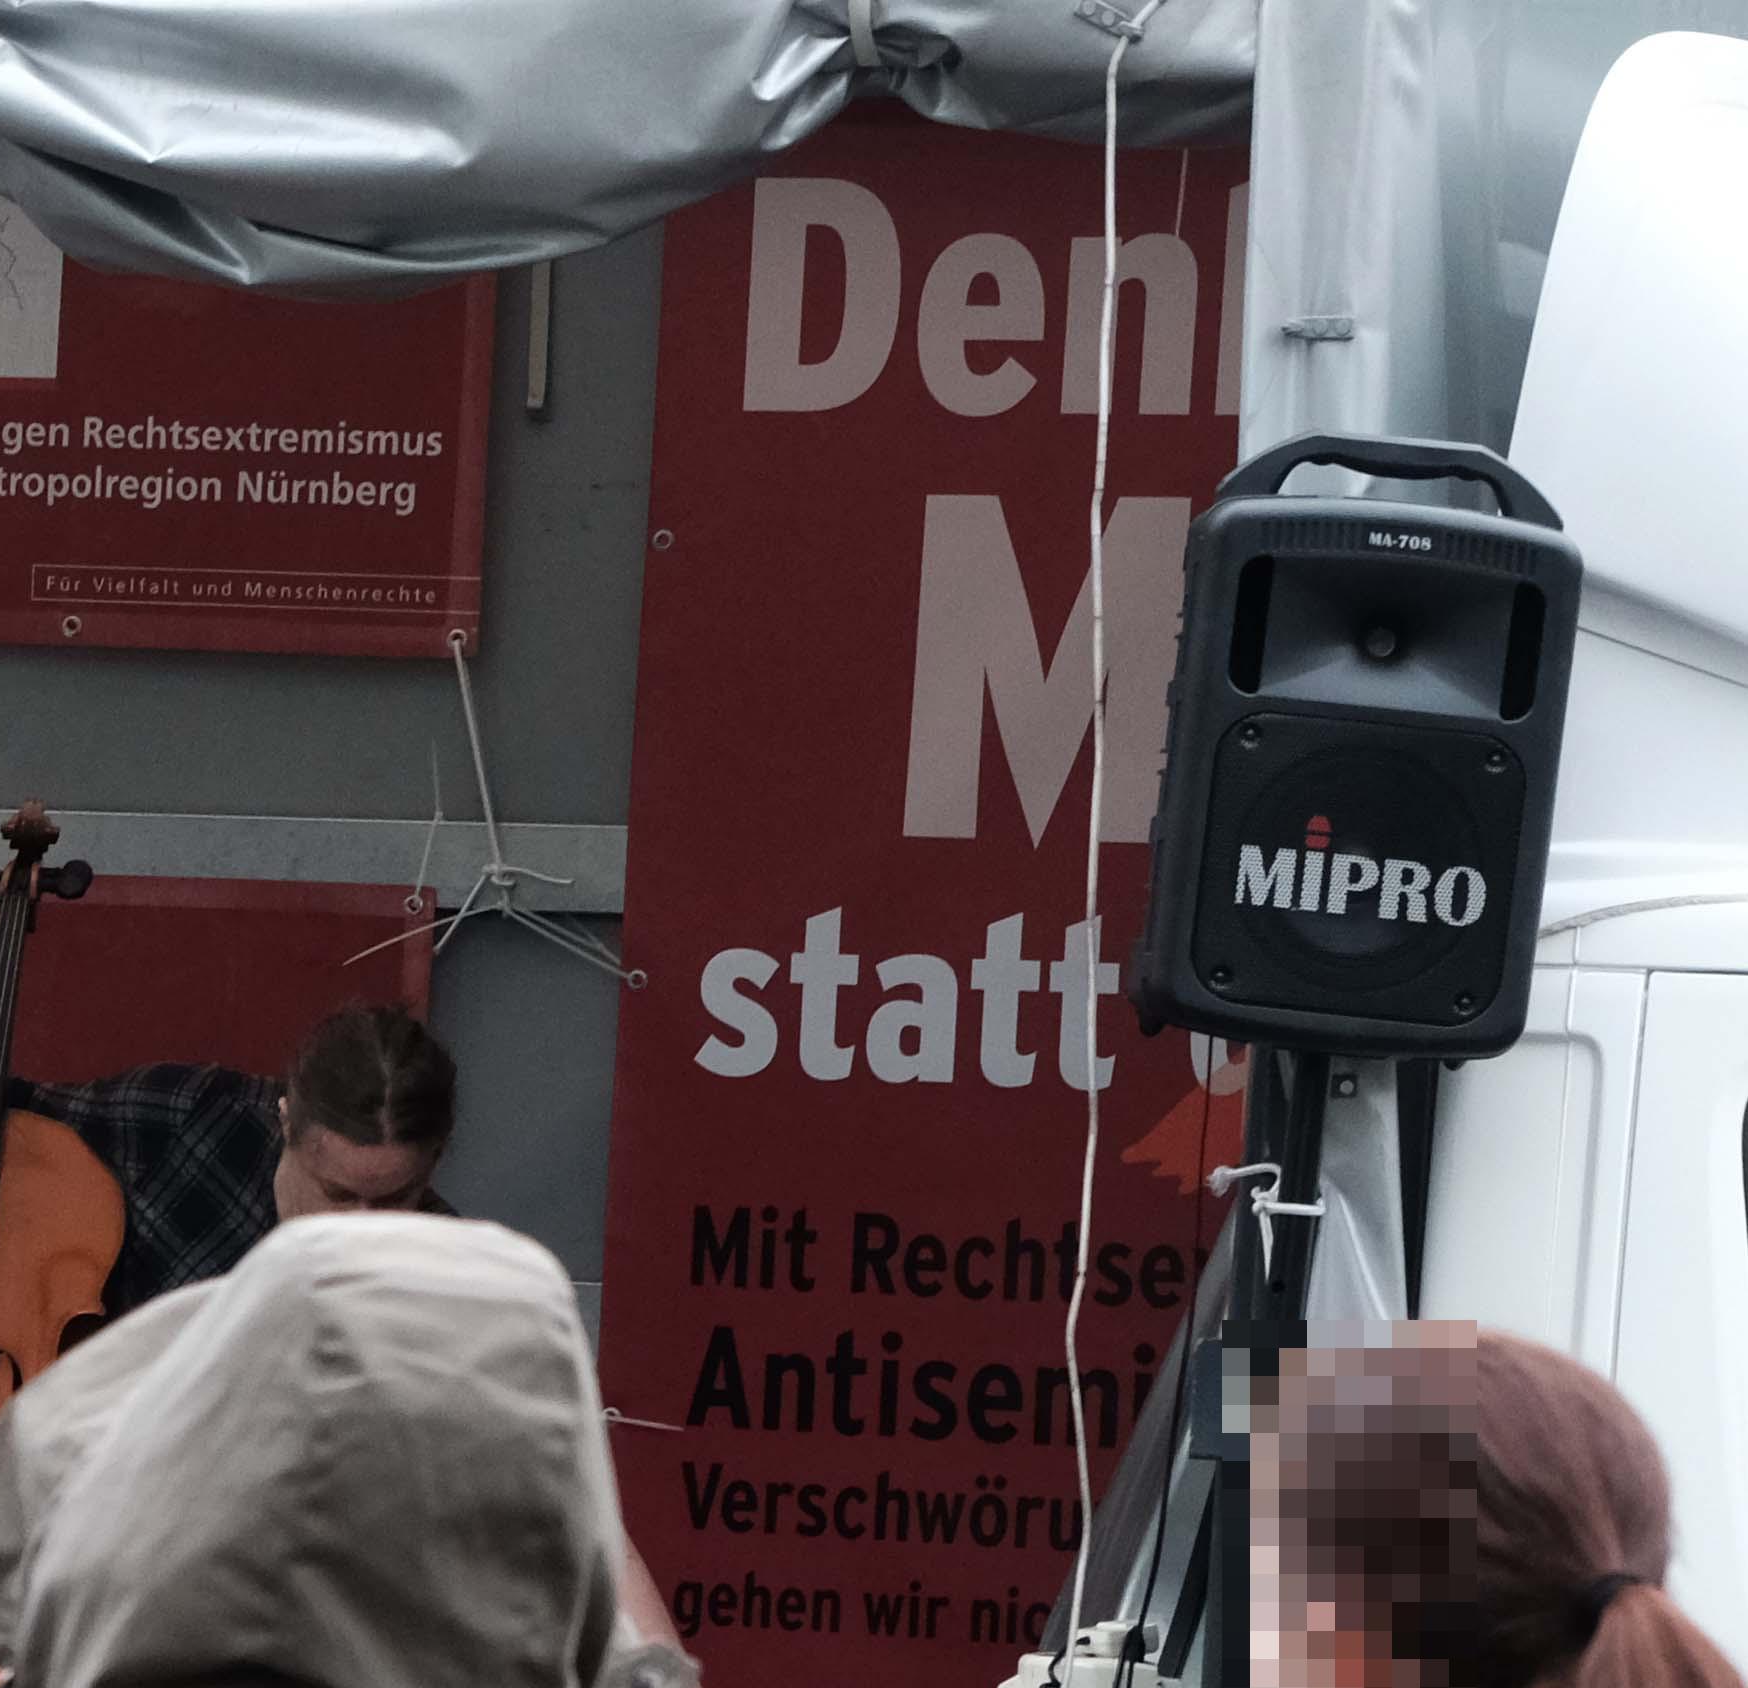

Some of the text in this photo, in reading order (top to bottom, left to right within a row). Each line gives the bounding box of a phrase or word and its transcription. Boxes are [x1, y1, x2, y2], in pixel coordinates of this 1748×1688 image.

[82, 415, 444, 457] Rechtsextremismus
[235, 470, 417, 516] Nürnberg
[1368, 531, 1433, 551] MA-708
[46, 574, 438, 607] Für Vielfalt und Menschenrechte
[694, 906, 1121, 1091] statt
[690, 1205, 1207, 1309] Mit Rechtse
[672, 1571, 841, 1640] gehen
[864, 1580, 949, 1639] wir
